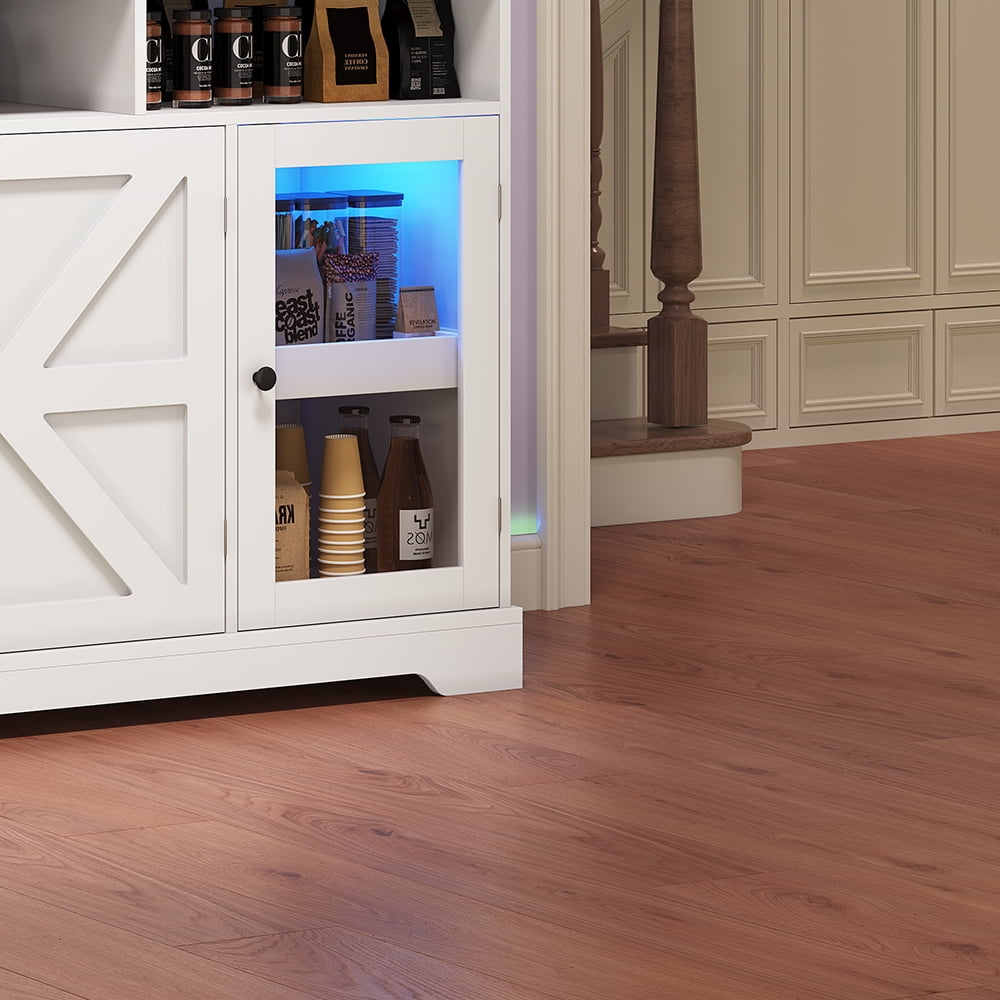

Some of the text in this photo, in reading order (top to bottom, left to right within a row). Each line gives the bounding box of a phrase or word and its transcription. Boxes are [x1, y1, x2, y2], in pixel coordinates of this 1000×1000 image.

[276, 289, 314, 315] east
[276, 302, 320, 332] coast
[285, 321, 318, 344] blend
